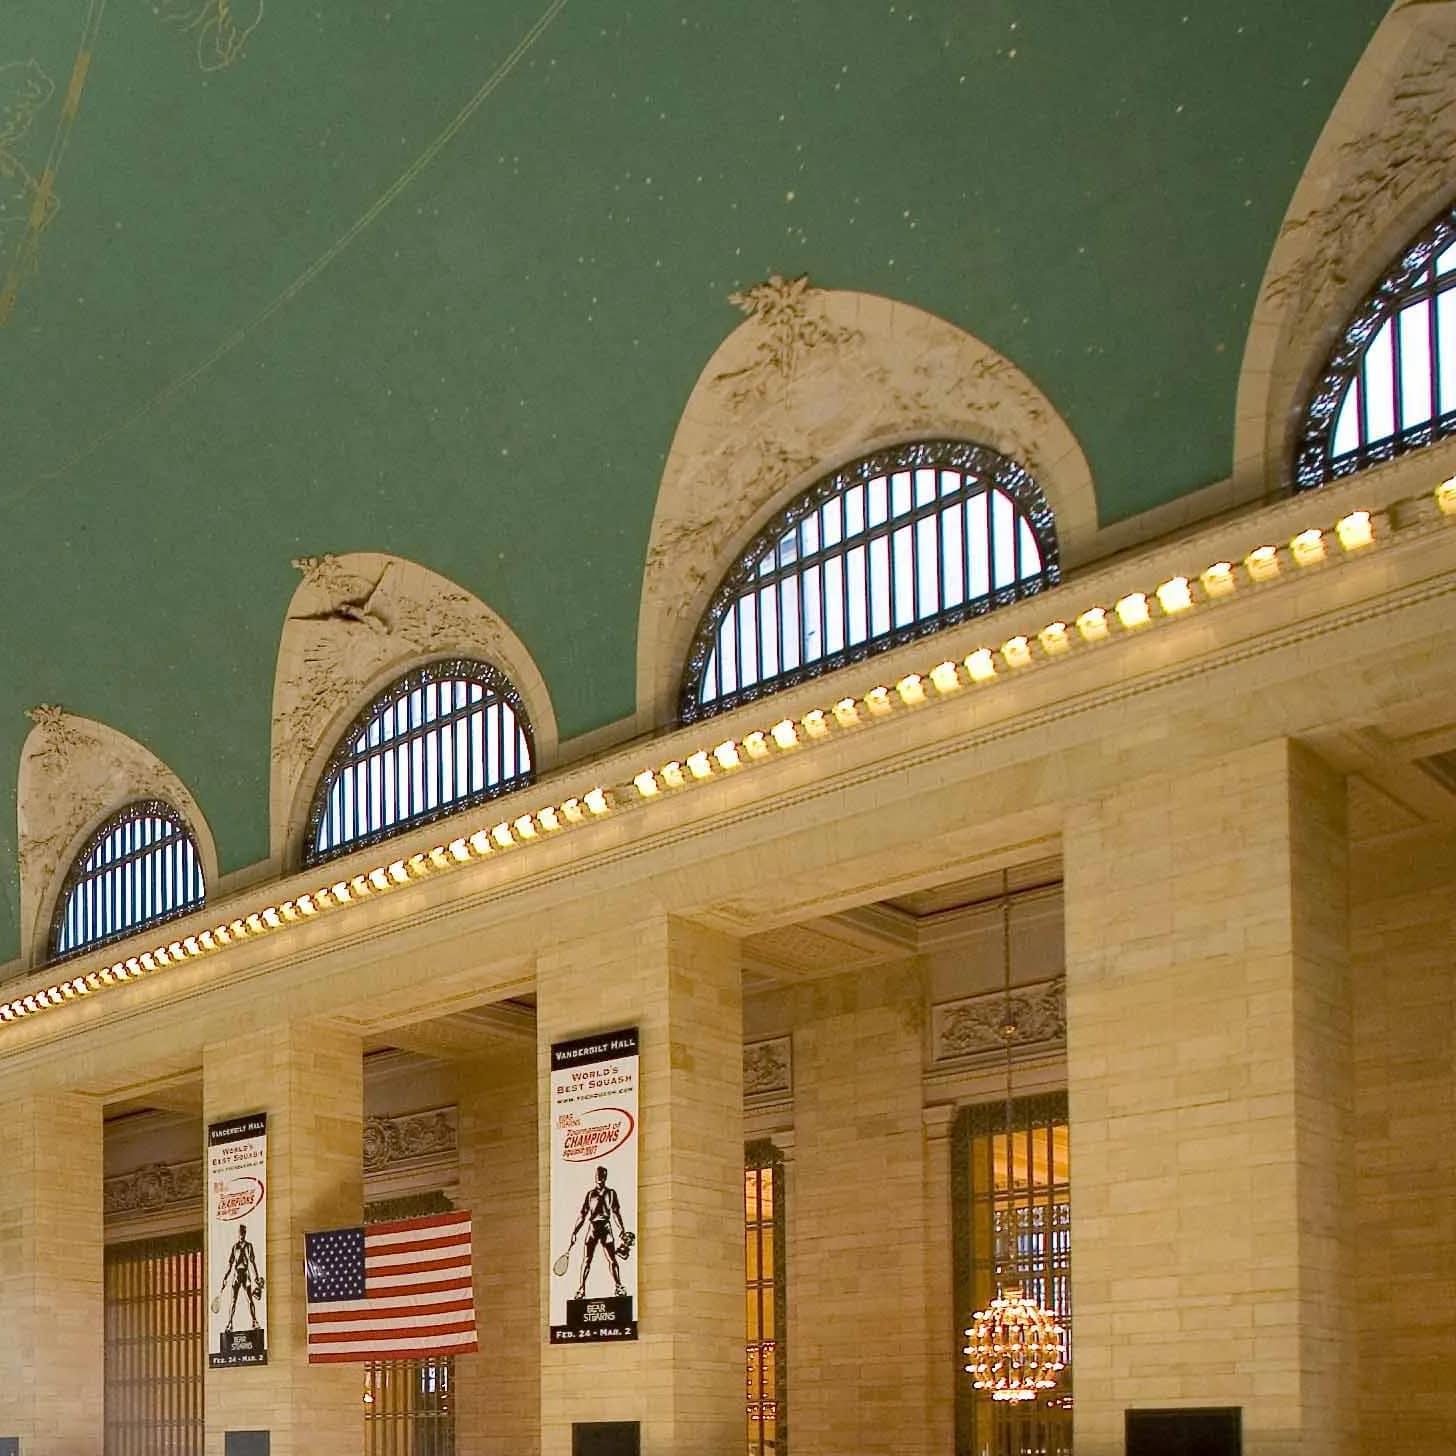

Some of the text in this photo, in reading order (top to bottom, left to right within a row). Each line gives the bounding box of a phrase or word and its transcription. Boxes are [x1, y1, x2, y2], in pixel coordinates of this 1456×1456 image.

[555, 1039, 636, 1060] VANDERBILT HALL
[572, 1065, 618, 1081] WORLD'S
[557, 1075, 632, 1094] BEST SQUASH
[564, 1129, 619, 1148] CHAMPIONS
[584, 1312, 616, 1322] STEARNS
[600, 1328, 622, 1336] MAR.
[625, 1327, 632, 1335] 2
